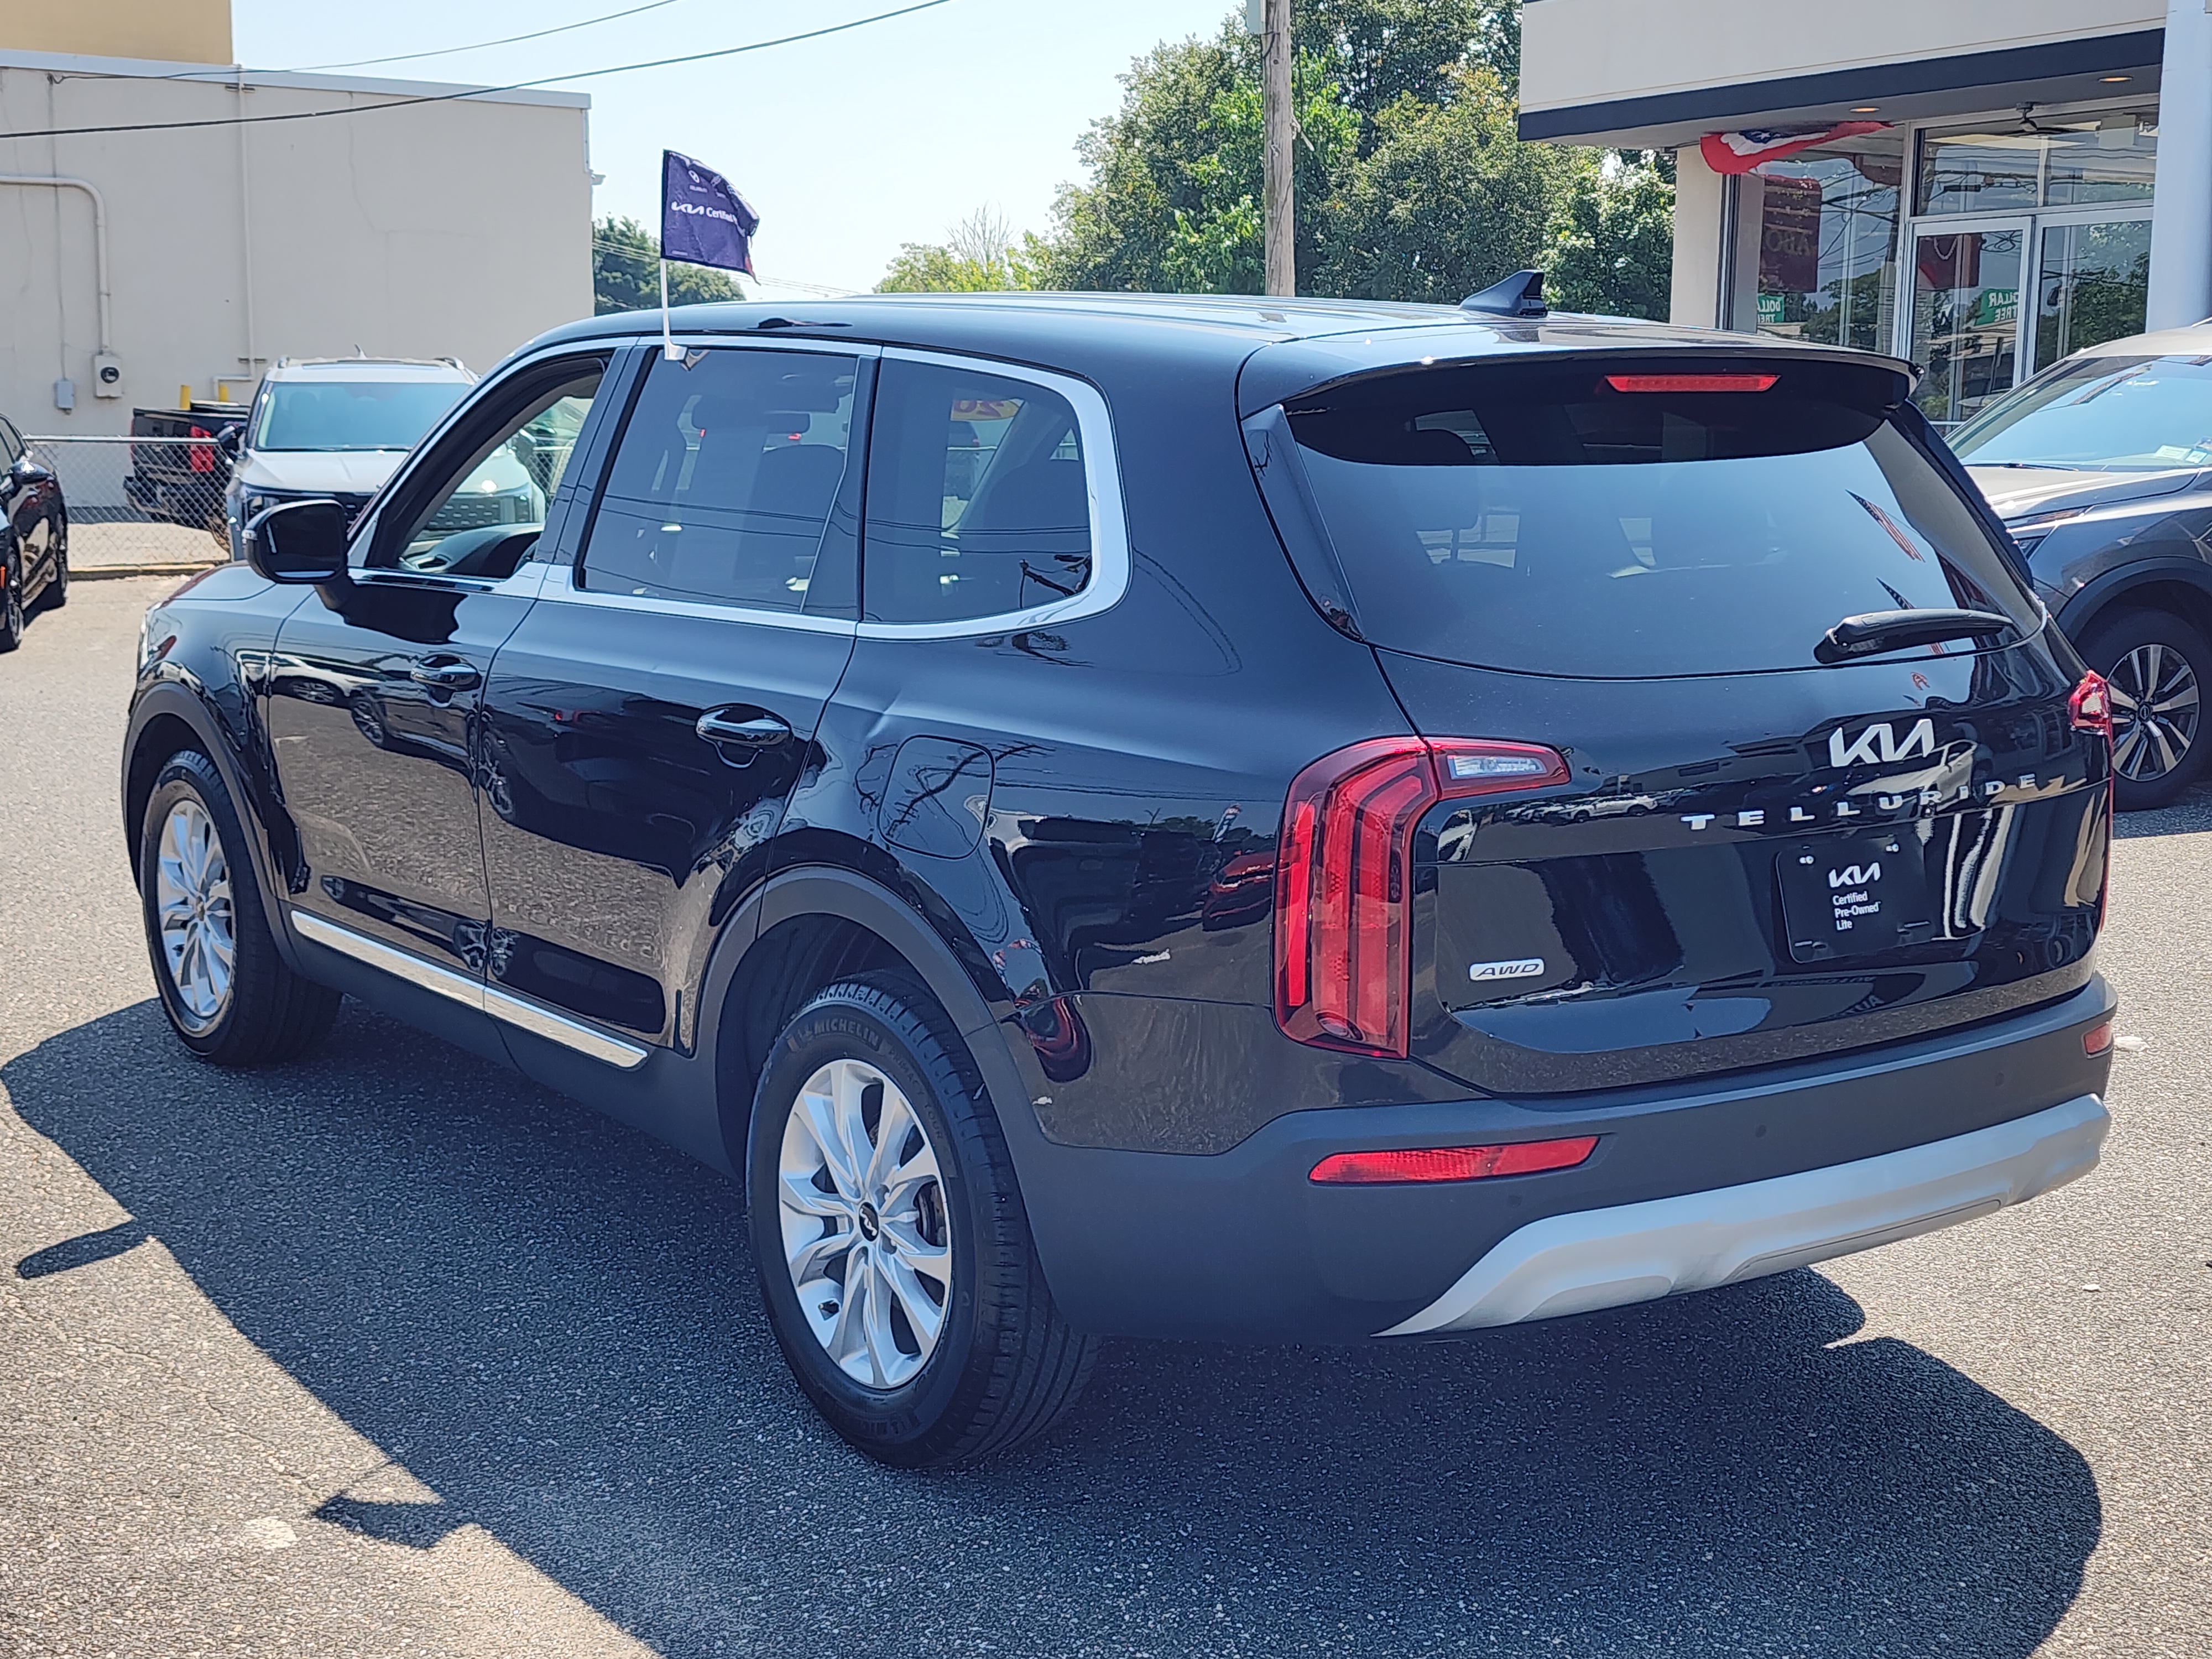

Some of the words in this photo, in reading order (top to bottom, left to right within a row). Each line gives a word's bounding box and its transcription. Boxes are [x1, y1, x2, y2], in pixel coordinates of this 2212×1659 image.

[671, 201, 705, 215] KIA
[1829, 719, 1935, 767] KIA
[1681, 774, 2037, 830] TELLURIDE
[1829, 862, 1881, 888] KIA
[1833, 890, 1868, 905] Certified
[1834, 901, 1880, 918] Pre-Owned
[1836, 920, 1853, 930] Lite
[1475, 963, 1540, 978] AWD
[815, 1019, 879, 1045] MICHELIN
